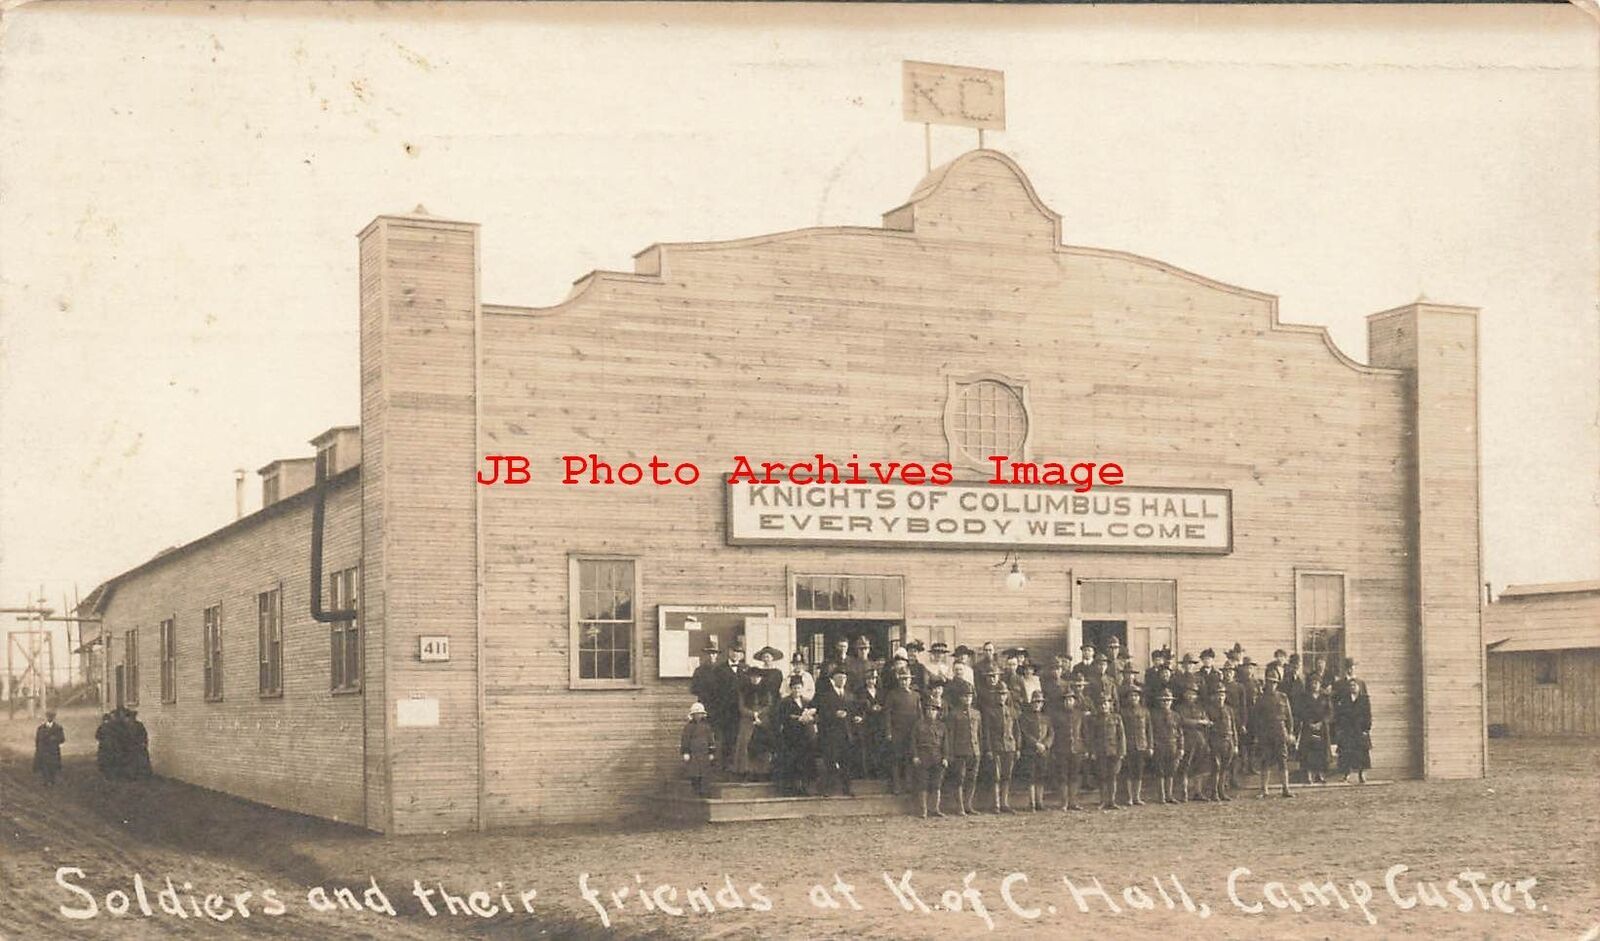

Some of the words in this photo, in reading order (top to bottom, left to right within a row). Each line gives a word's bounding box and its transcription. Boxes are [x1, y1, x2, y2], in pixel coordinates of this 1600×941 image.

[750, 486, 897, 509] KNIGHTS
[907, 491, 948, 510] OF
[959, 492, 1131, 516] COLUMBUS
[1142, 498, 1219, 518] HALL
[759, 514, 1012, 536] EVERYBODY
[1028, 520, 1206, 539] WELCOME
[424, 642, 446, 654] 411
